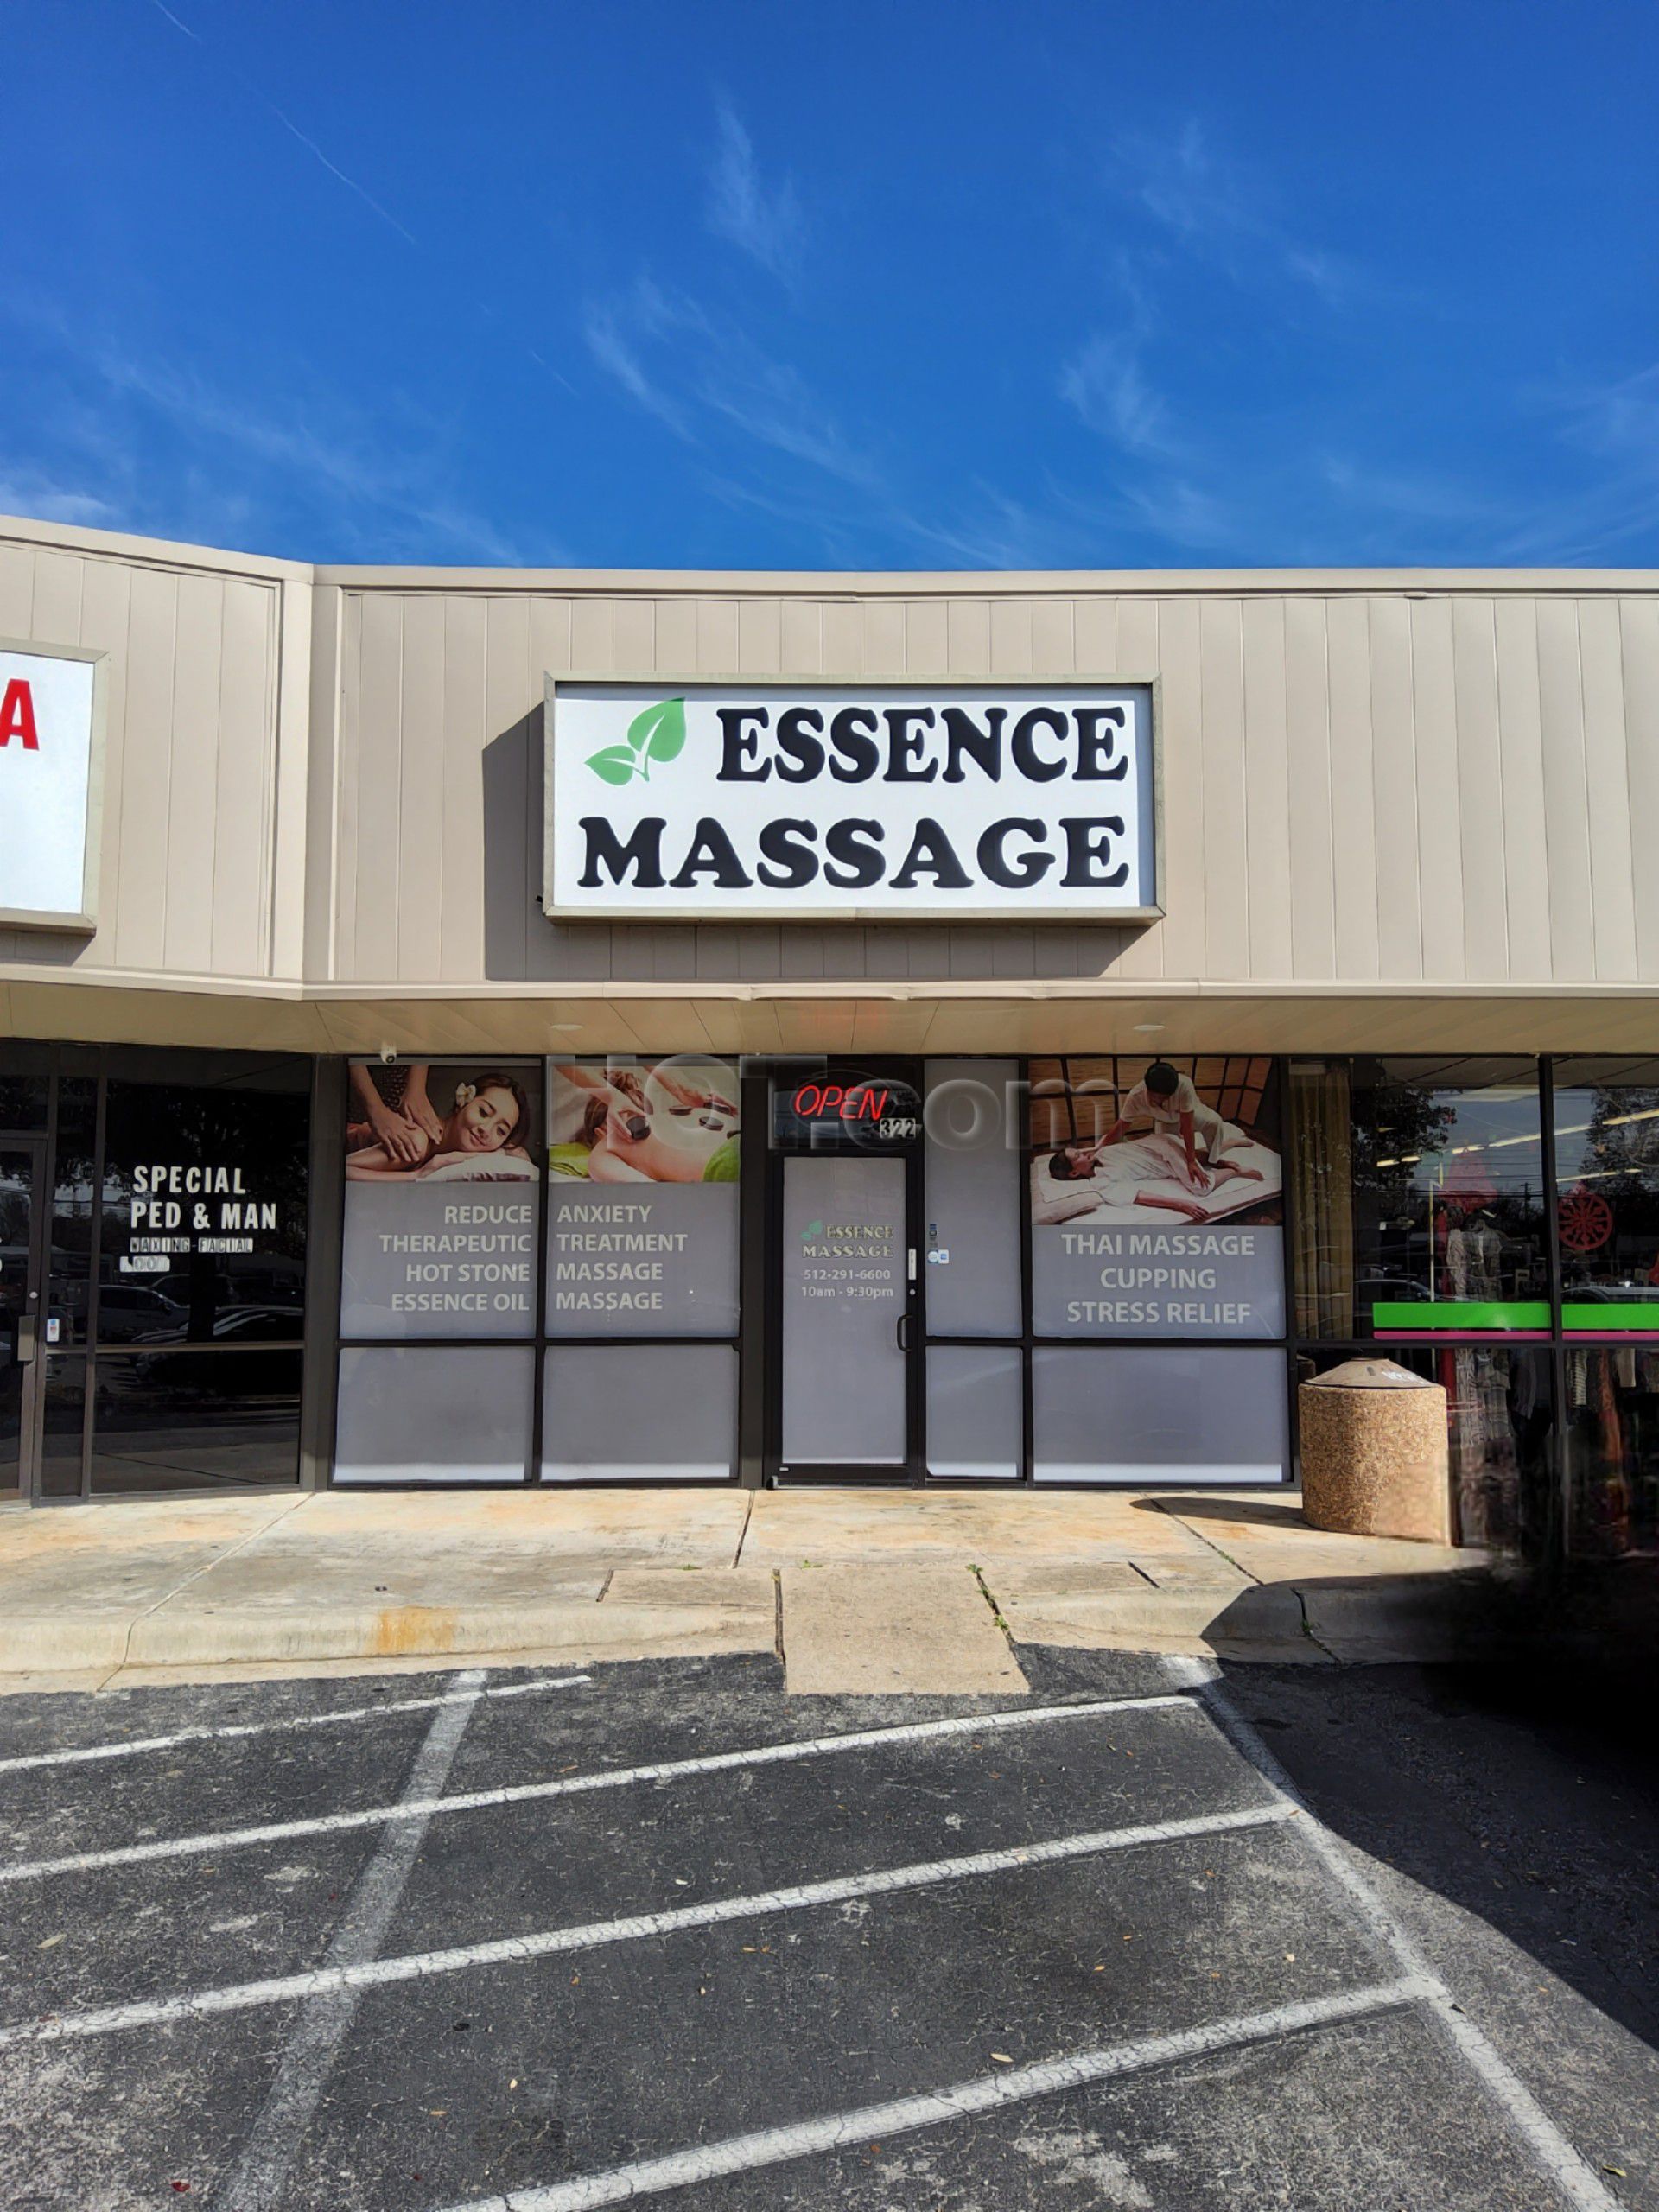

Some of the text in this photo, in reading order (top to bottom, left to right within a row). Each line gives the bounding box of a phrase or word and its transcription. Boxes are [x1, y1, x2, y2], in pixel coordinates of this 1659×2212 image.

[716, 706, 1128, 783] ESSENCE
[577, 816, 1129, 888] MASSAGE
[794, 1084, 890, 1121] OPEN
[880, 1118, 916, 1139] 322
[133, 1166, 246, 1194] SPECIAL
[131, 1201, 276, 1230] PED & MAN
[444, 1205, 652, 1224] REDUCE ANXIETY
[825, 1224, 893, 1240] ESSENCE
[379, 1234, 688, 1253] THERAPEUTIC TREATMENT
[802, 1244, 893, 1259] MASSAGE
[1061, 1234, 1255, 1256] THAI MASSAGE
[406, 1263, 664, 1282] HOT STONE MASSAGE
[804, 1269, 891, 1280] 512-291-6600
[1100, 1268, 1217, 1289] CUPPING
[391, 1292, 664, 1312] ESSENCE OIL MASSAGE
[802, 1287, 836, 1297] 10am
[846, 1286, 894, 1300] 9:30pm
[1067, 1301, 1251, 1325] STRESS RELIEF
